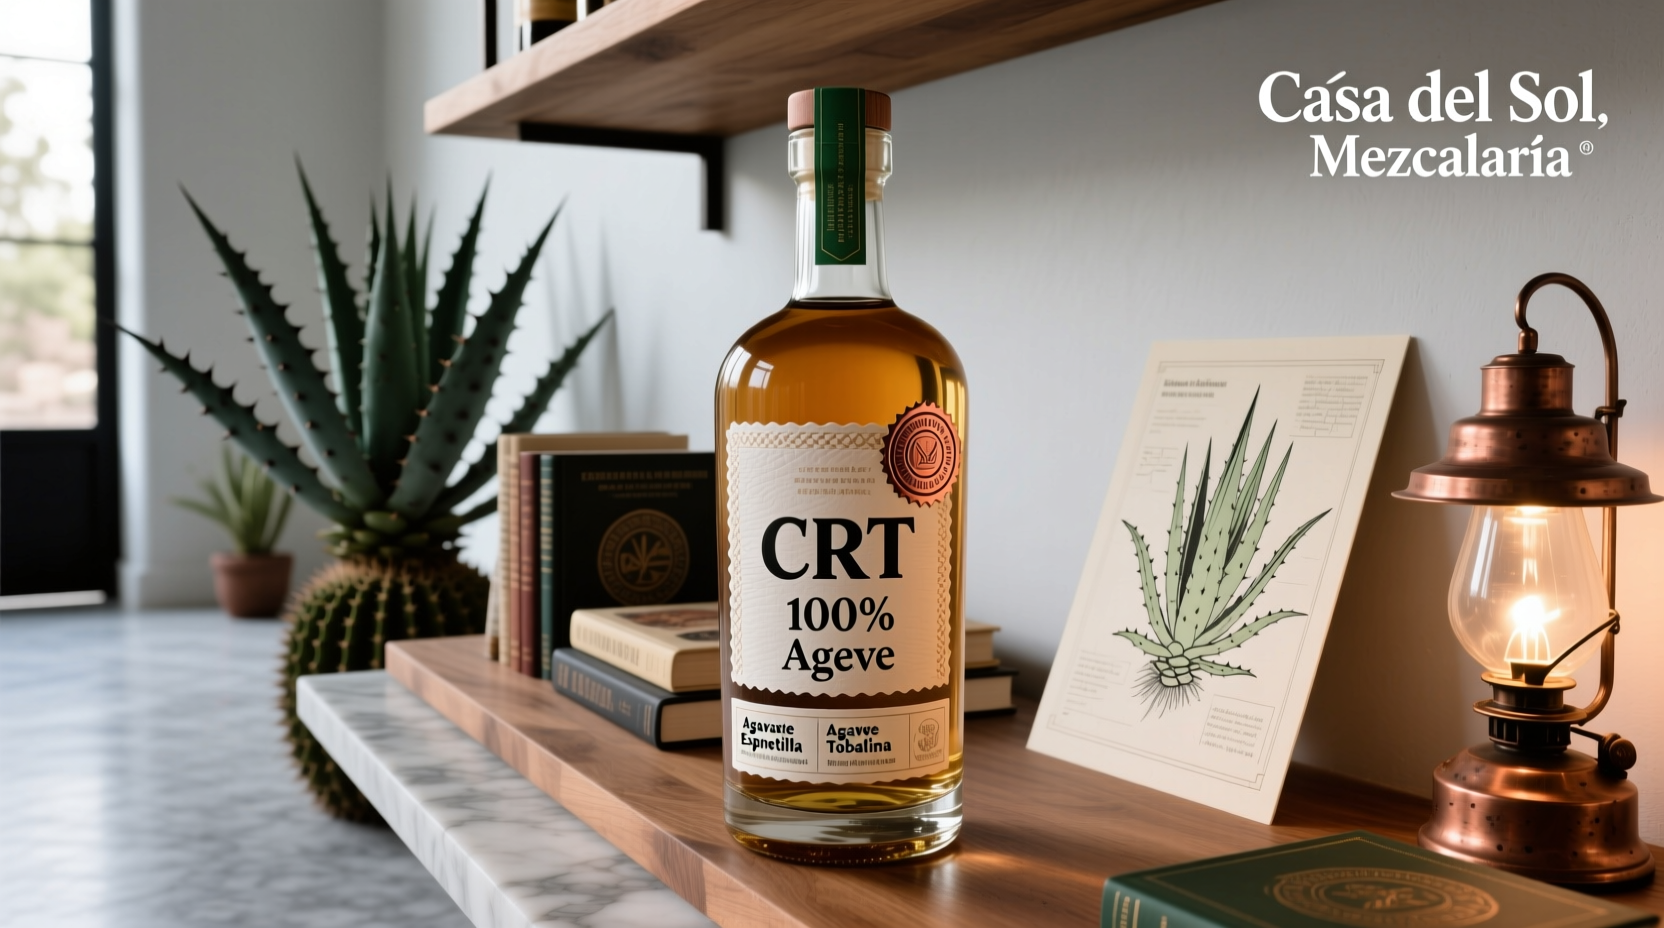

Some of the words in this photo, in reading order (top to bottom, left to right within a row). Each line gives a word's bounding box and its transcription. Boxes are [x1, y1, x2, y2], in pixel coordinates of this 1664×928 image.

[761, 516, 916, 581] CRT
[787, 596, 895, 633] 100%
[781, 638, 895, 682] Ageve
